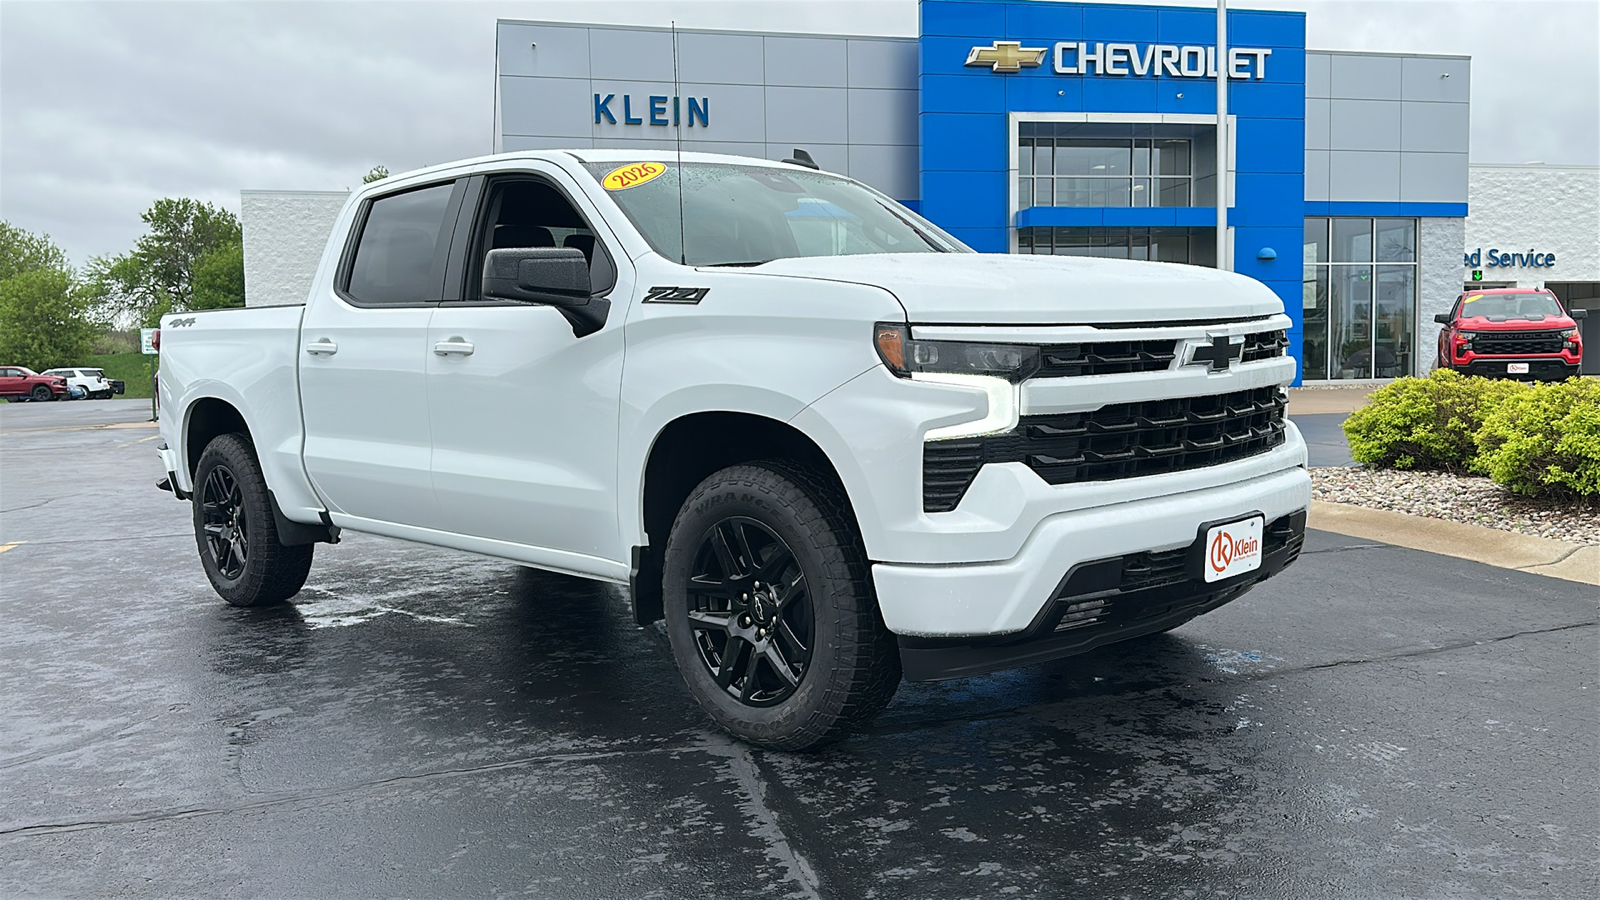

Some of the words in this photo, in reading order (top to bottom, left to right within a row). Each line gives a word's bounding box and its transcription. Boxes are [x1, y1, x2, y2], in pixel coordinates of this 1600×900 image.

[1054, 41, 1272, 79] CHEVROLET
[594, 93, 709, 127] KLEIN
[612, 163, 657, 187] 2026
[1488, 248, 1556, 268] Service
[641, 286, 711, 305] Z71
[1234, 536, 1258, 557] Klein
